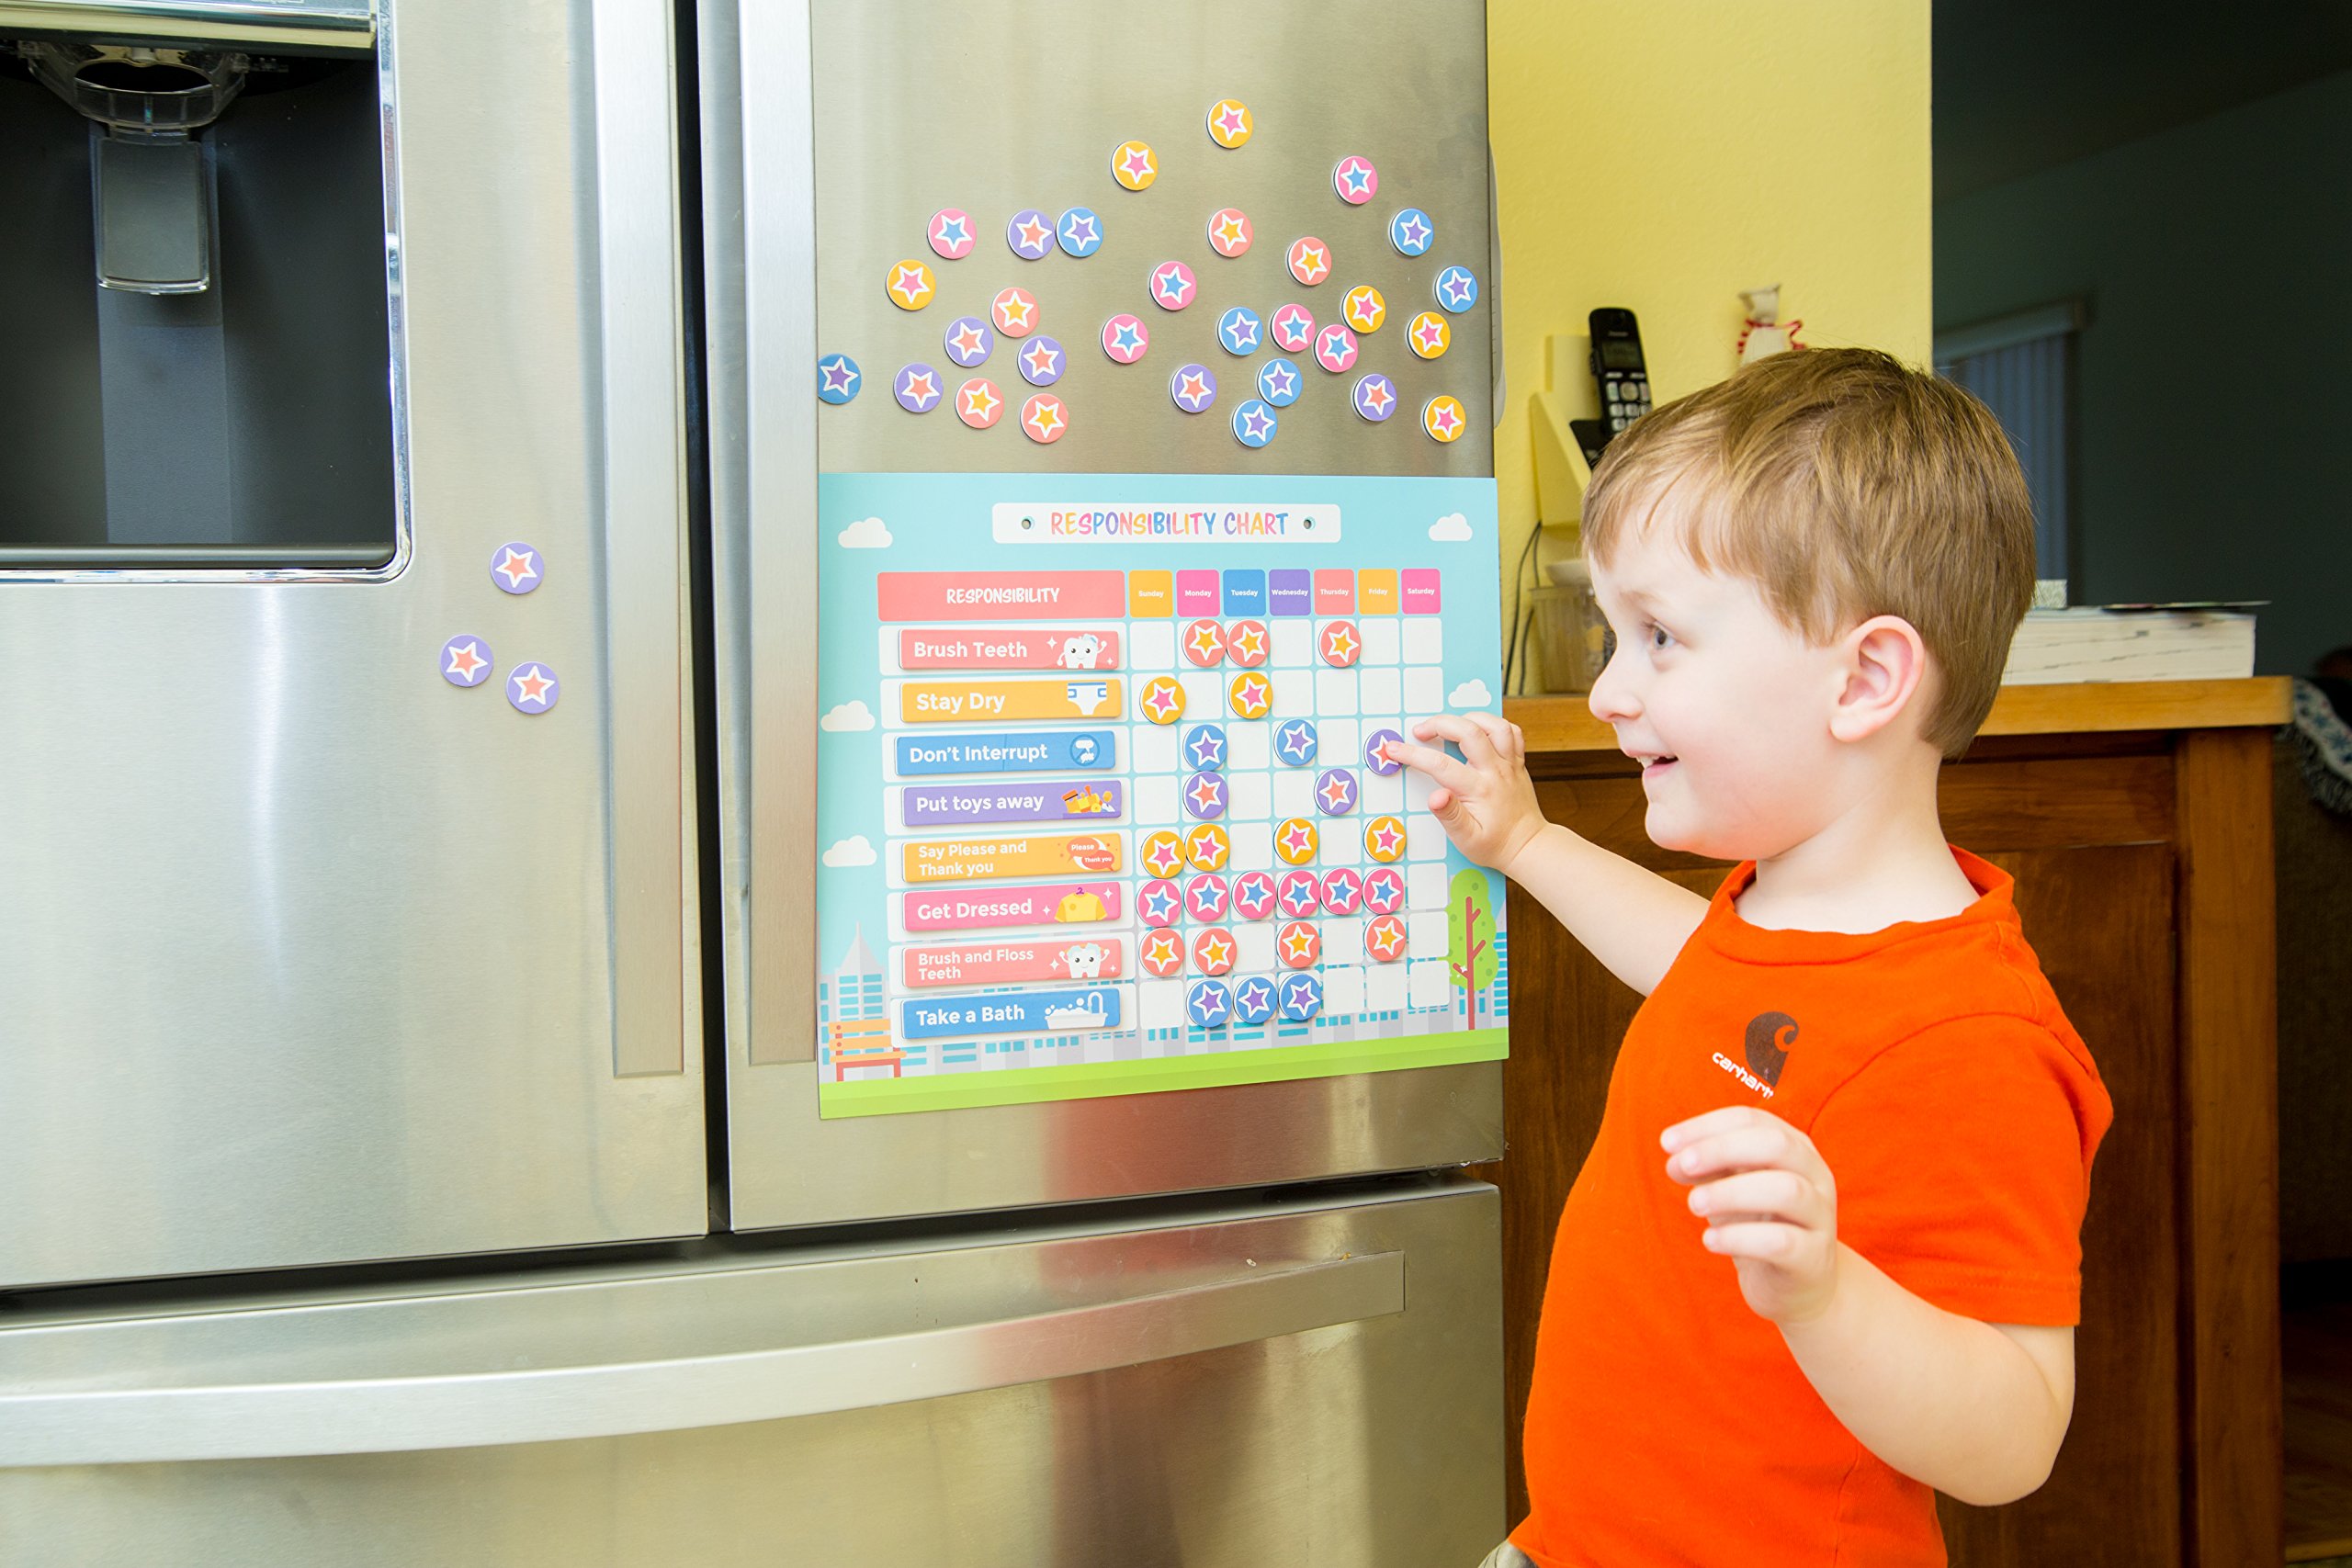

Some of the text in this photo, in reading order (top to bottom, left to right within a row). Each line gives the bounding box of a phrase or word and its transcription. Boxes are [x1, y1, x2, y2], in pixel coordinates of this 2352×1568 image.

[1051, 511, 1289, 536] RESPONSIBILITY CHART
[946, 587, 1060, 604] RESPONSIBILITY
[1138, 590, 1164, 599] Sunday
[1184, 589, 1212, 598] Monday
[1230, 589, 1259, 598] Tuesday
[1271, 588, 1309, 597] Wednesday
[1320, 588, 1349, 597] Thursday
[1368, 588, 1388, 596] Friday
[1407, 587, 1435, 596] Saturday
[914, 641, 1028, 659] Brush Teeth
[916, 692, 1005, 715] Stay Dry
[910, 743, 1048, 763] Don’t Interrupt
[916, 794, 1045, 815] Put toys away
[919, 840, 1027, 861] Say Please and
[919, 863, 994, 877] Thank you
[917, 898, 1033, 920] Get Dressed
[918, 947, 1035, 966] Brush and Floss
[918, 966, 962, 981] Teeth
[916, 1004, 1025, 1027] Take a Bath
